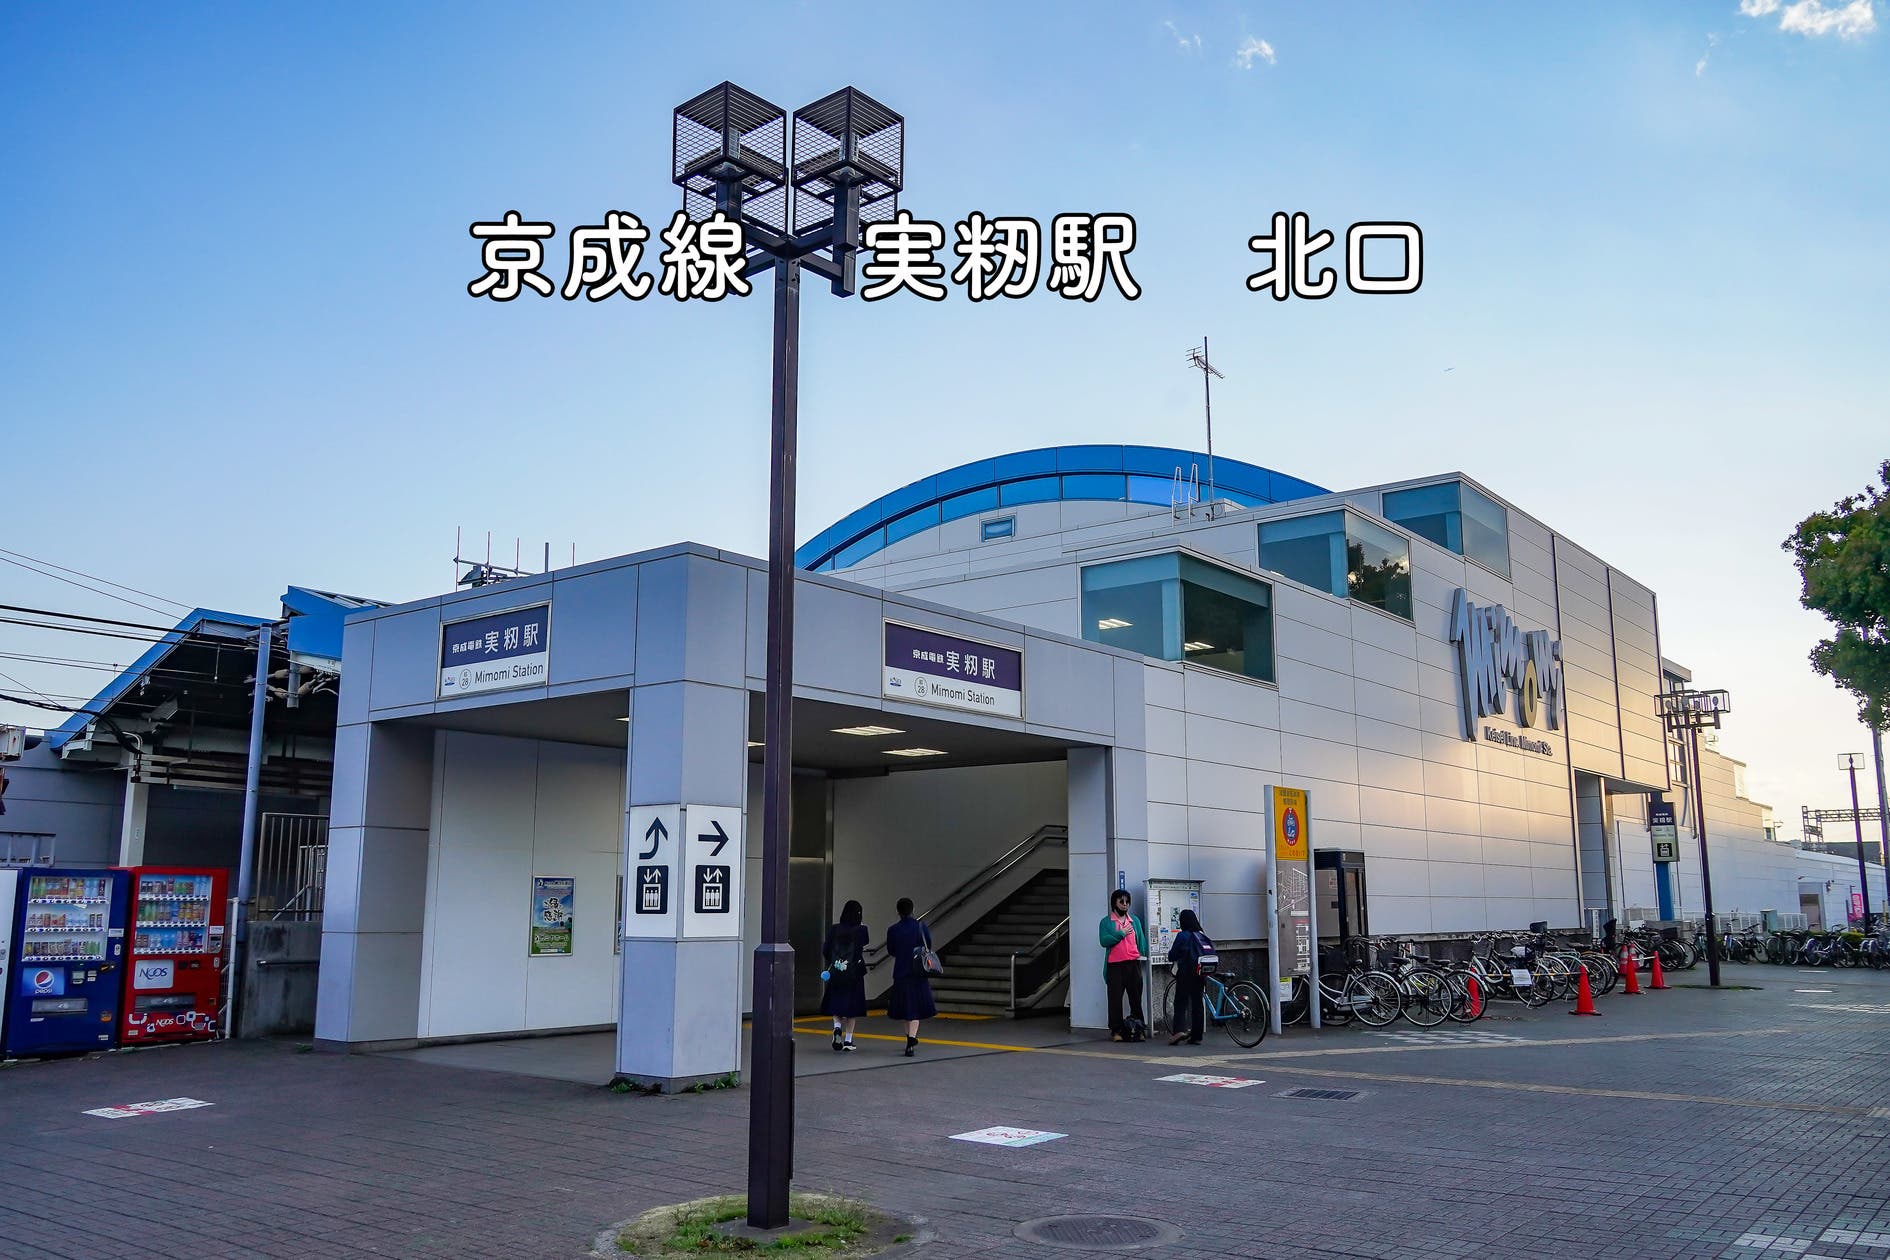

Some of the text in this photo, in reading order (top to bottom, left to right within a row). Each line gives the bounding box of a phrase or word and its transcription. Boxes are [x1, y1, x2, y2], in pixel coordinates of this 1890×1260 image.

[484, 623, 539, 654] 実籾駅
[475, 663, 544, 684] Mimomi Station
[946, 651, 996, 680] 実籾駅
[931, 682, 995, 706] Mimomi Station
